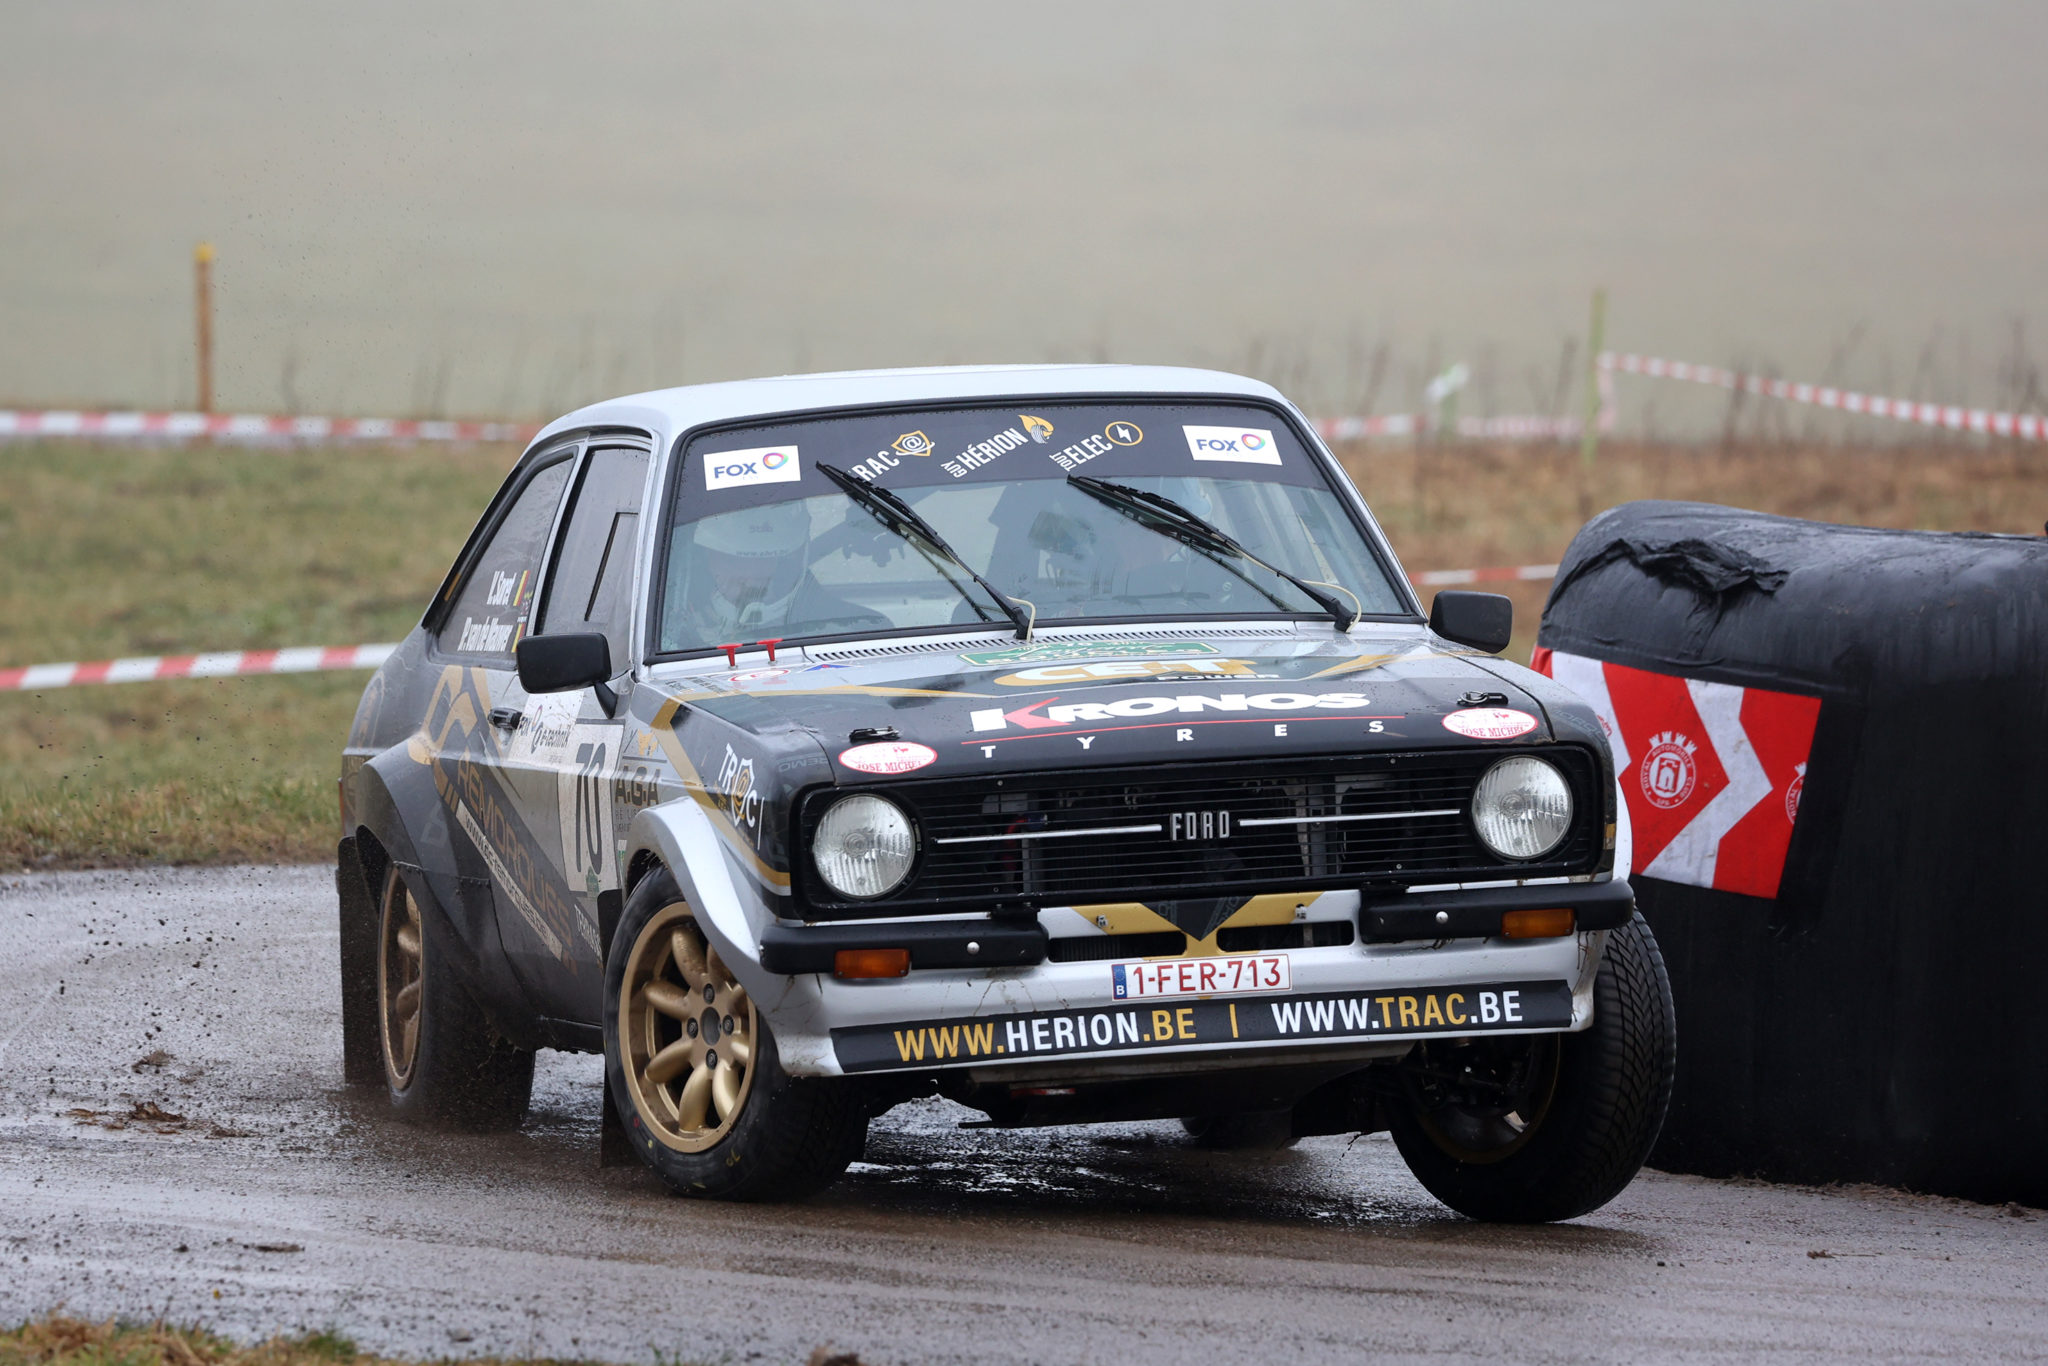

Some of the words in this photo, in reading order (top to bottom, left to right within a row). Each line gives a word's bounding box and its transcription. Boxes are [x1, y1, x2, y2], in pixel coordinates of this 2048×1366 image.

[955, 427, 1030, 470] HÉRION
[1062, 433, 1114, 465] ELEC
[1195, 438, 1240, 452] FOX
[713, 461, 758, 479] FOX
[848, 449, 900, 483] RAC
[940, 460, 968, 479] GUY
[1048, 452, 1077, 473] TOUT
[1156, 673, 1280, 681] POWER
[969, 692, 1371, 732] KRONOS
[575, 742, 607, 876] 70
[1170, 810, 1230, 841] FORD
[1116, 985, 1126, 996] B
[1133, 958, 1281, 995] 1-FER-713
[893, 1007, 1198, 1062] WWW.HERION.BE
[1270, 990, 1524, 1034] WWW.TRAC.BE
